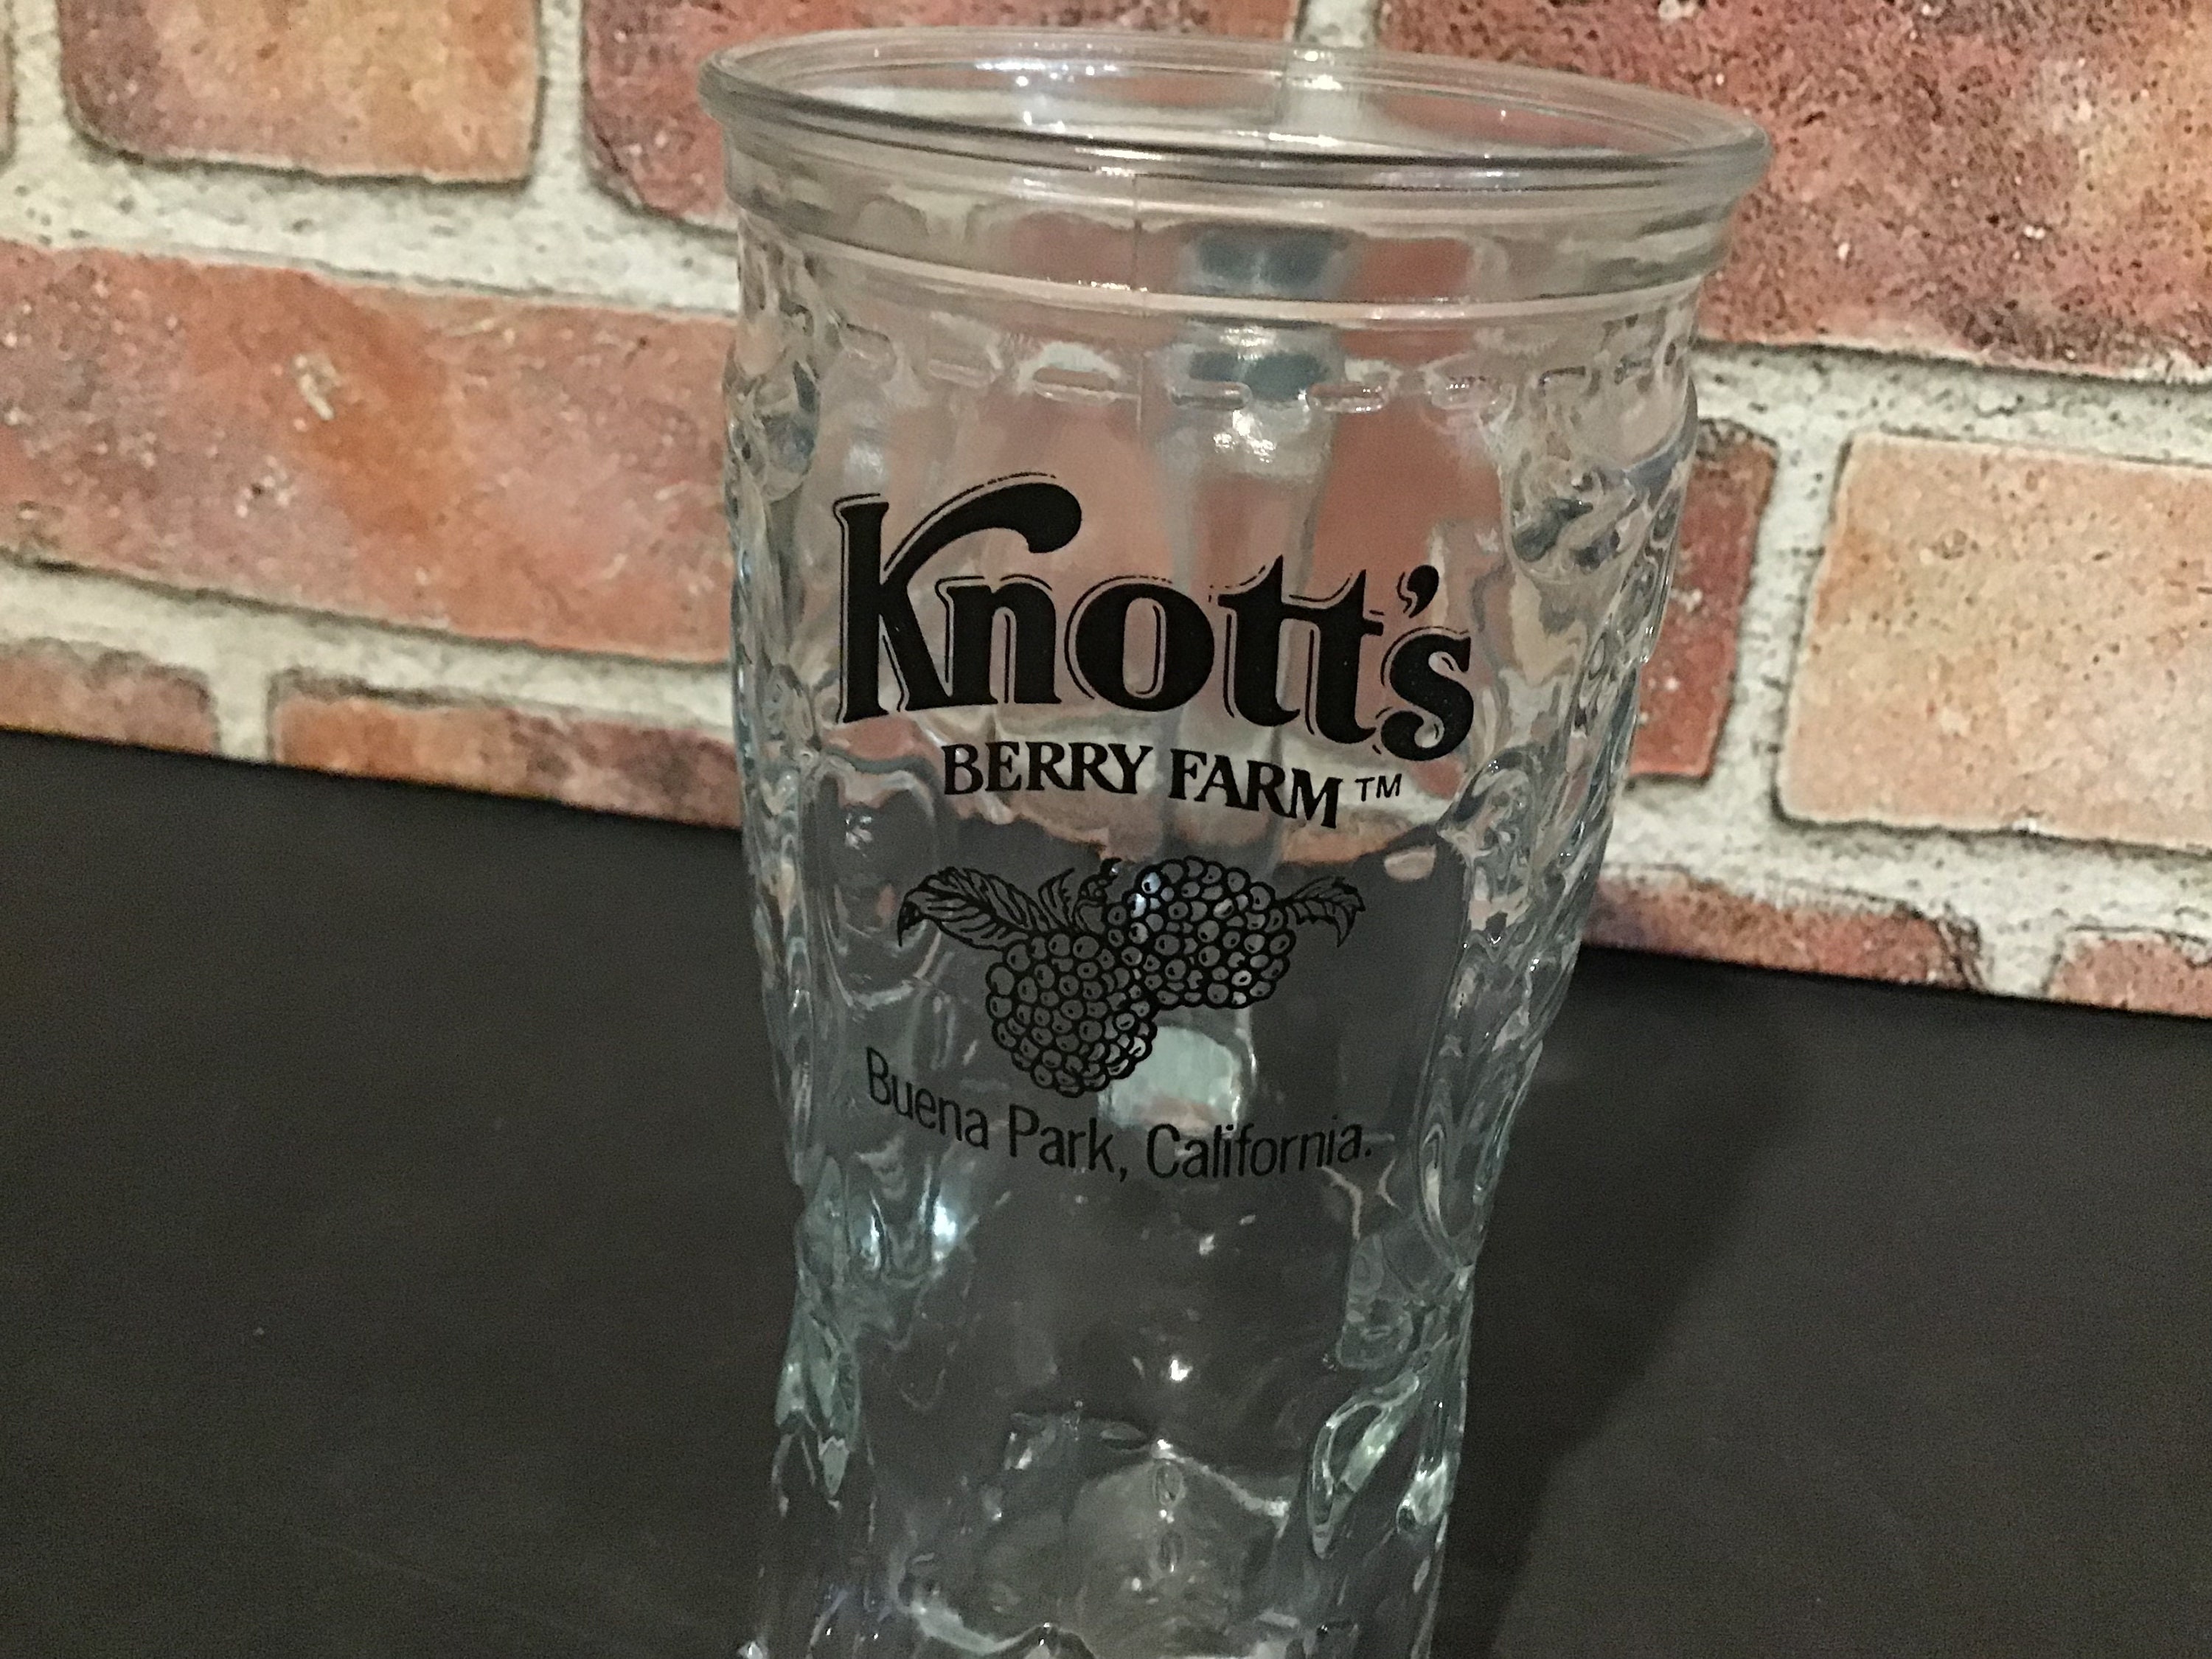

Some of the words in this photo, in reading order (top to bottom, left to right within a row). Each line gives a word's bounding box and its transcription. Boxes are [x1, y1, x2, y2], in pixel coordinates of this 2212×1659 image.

[833, 473, 1475, 761] Knott's
[942, 740, 1153, 796] BERRY
[1168, 747, 1343, 830] FARM
[866, 1046, 990, 1150] Buena
[1008, 1103, 1128, 1182] Park,
[1146, 1113, 1372, 1180] California.
